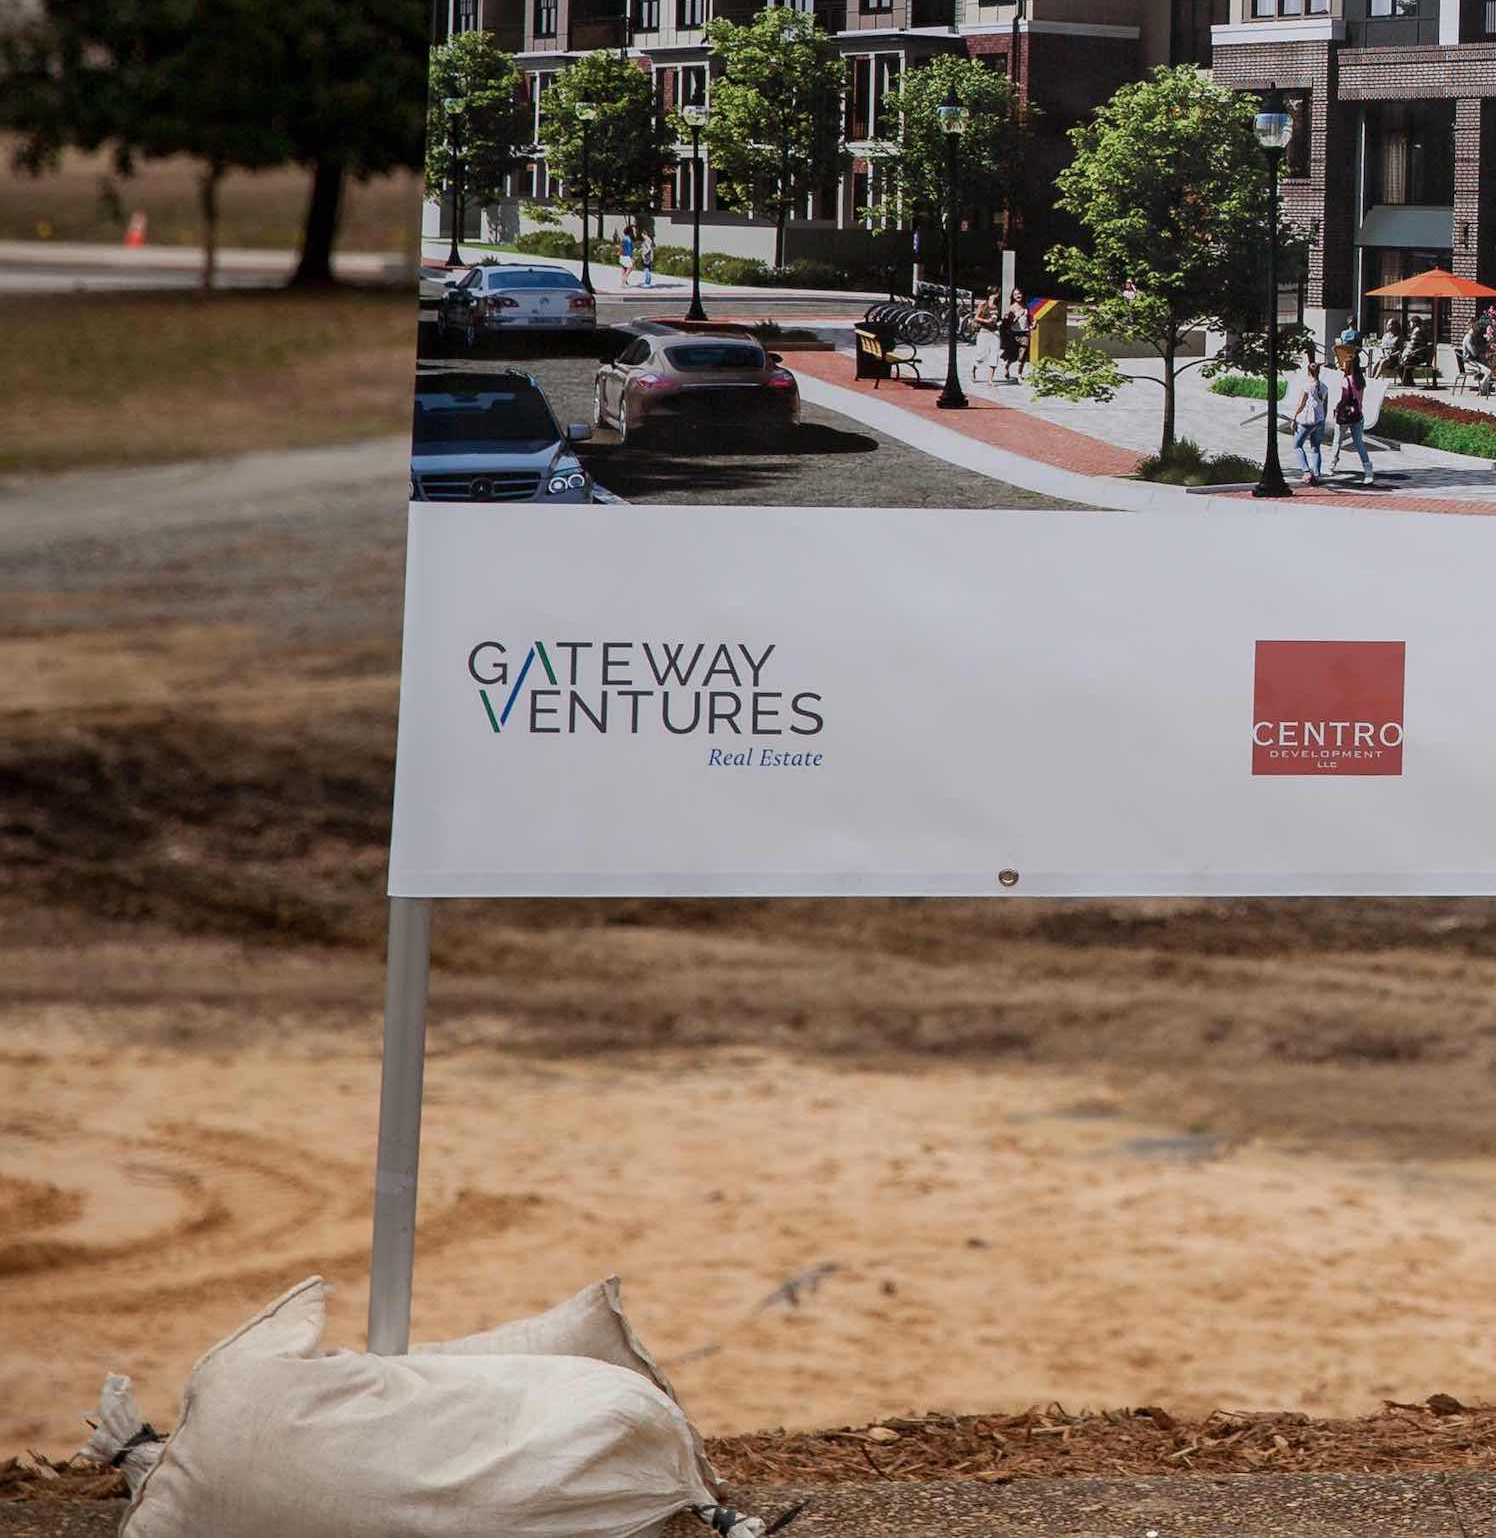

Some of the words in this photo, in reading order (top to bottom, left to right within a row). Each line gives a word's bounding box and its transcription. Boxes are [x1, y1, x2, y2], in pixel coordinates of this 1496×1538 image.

[468, 640, 776, 688] GATEWAY
[479, 688, 825, 736] VENTURES
[1252, 720, 1405, 747] CENTRO
[708, 747, 753, 767] Real
[759, 747, 824, 767] Estate
[1269, 750, 1383, 759] DEVELOPMENT
